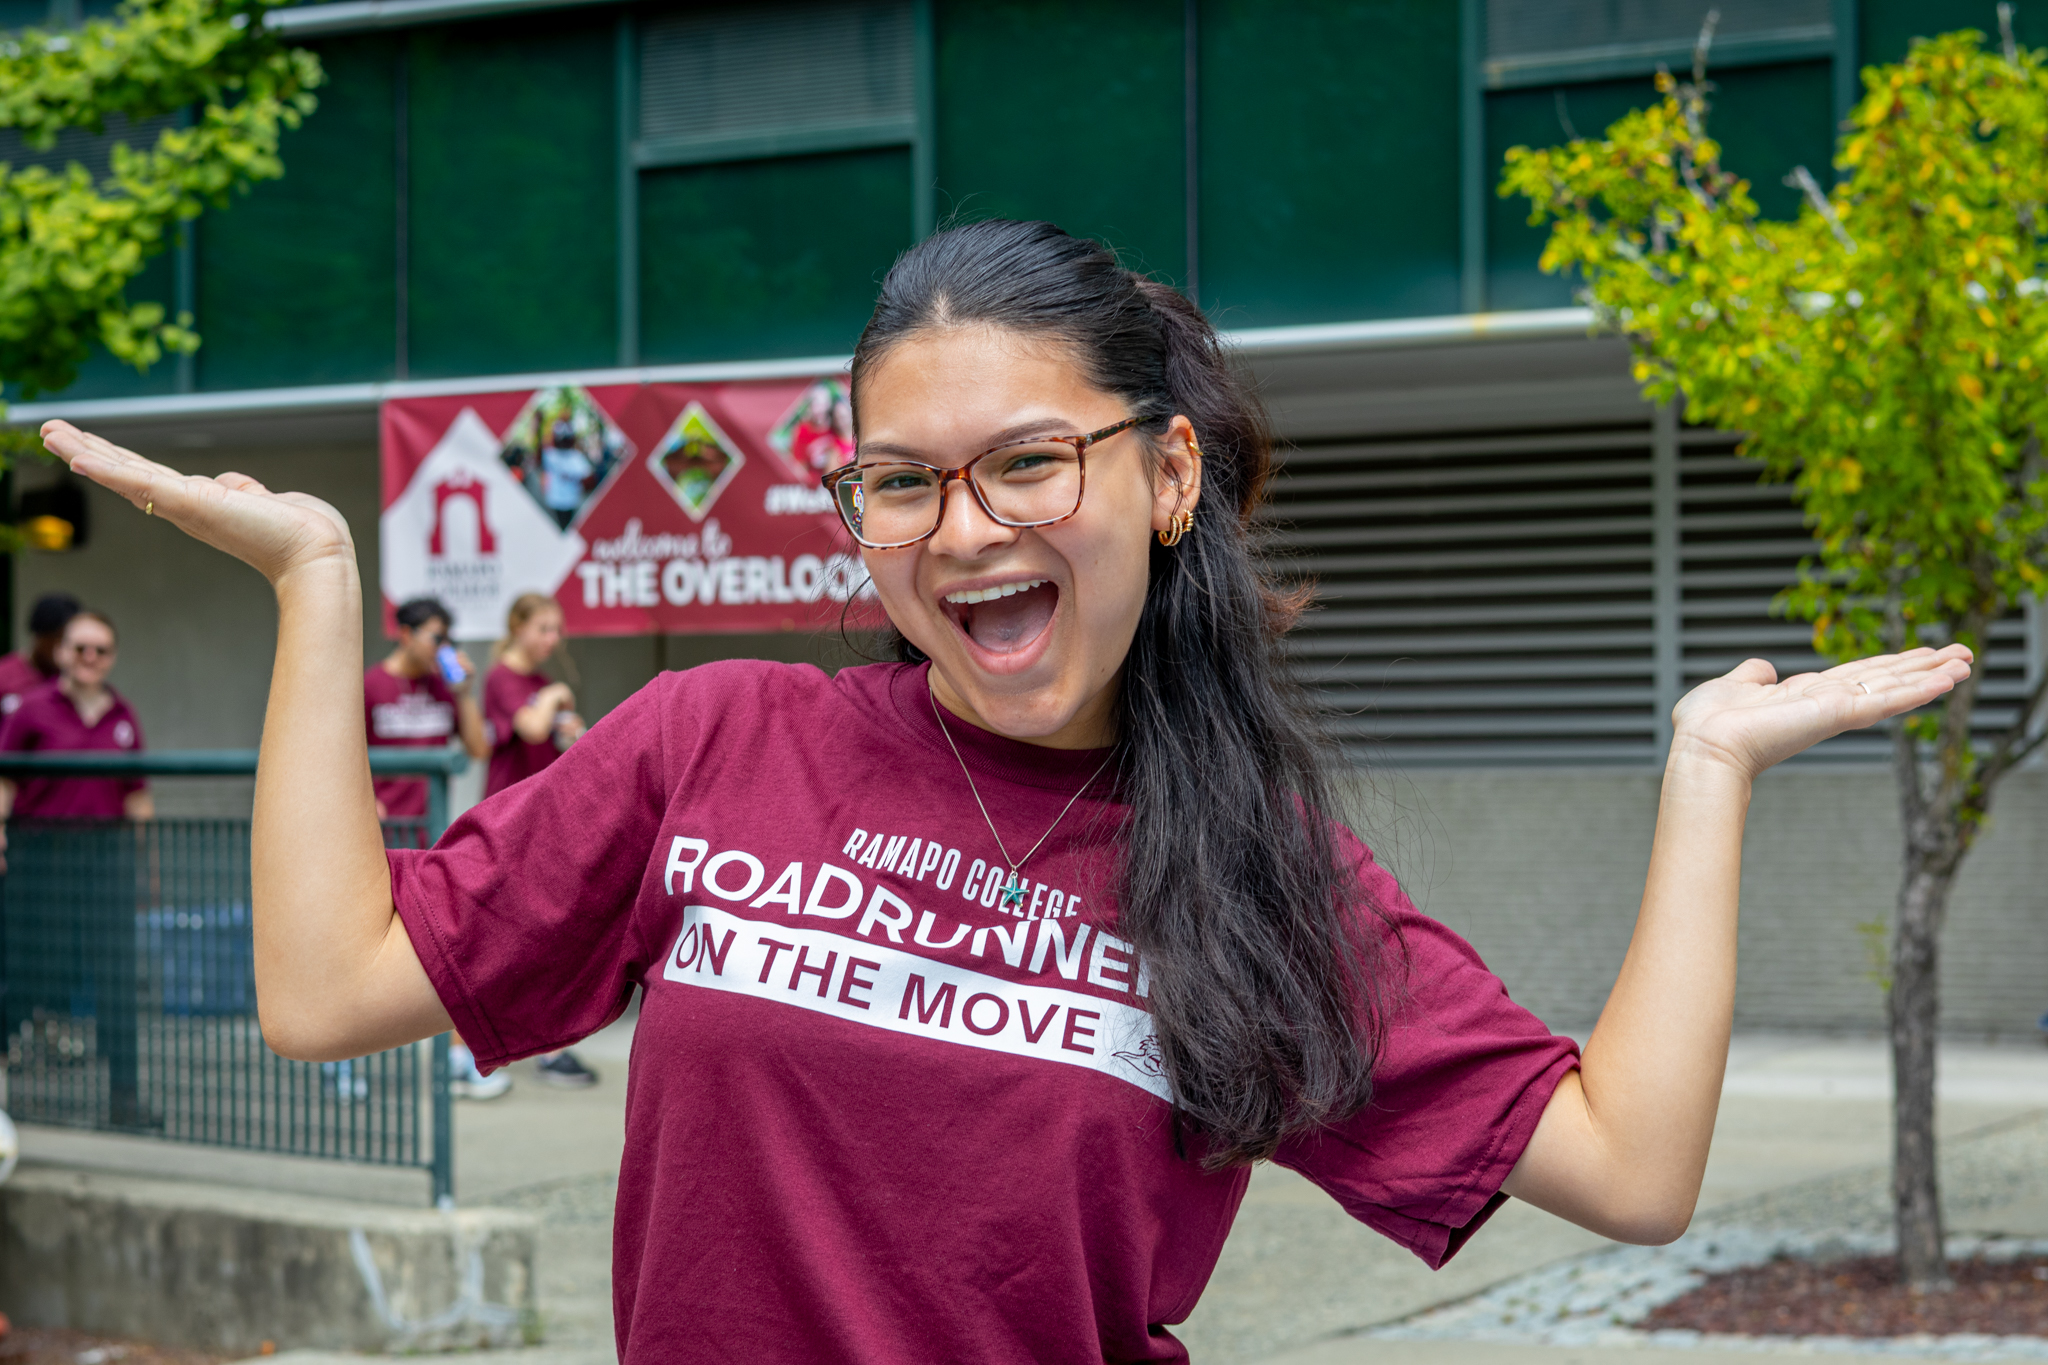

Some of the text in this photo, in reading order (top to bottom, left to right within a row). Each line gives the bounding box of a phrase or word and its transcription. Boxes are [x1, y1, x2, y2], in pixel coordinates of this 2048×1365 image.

[592, 516, 732, 560] welcome to
[577, 558, 660, 608] THE
[842, 828, 961, 890] RAMAPO
[676, 922, 1101, 1055] ON THE MOVE
